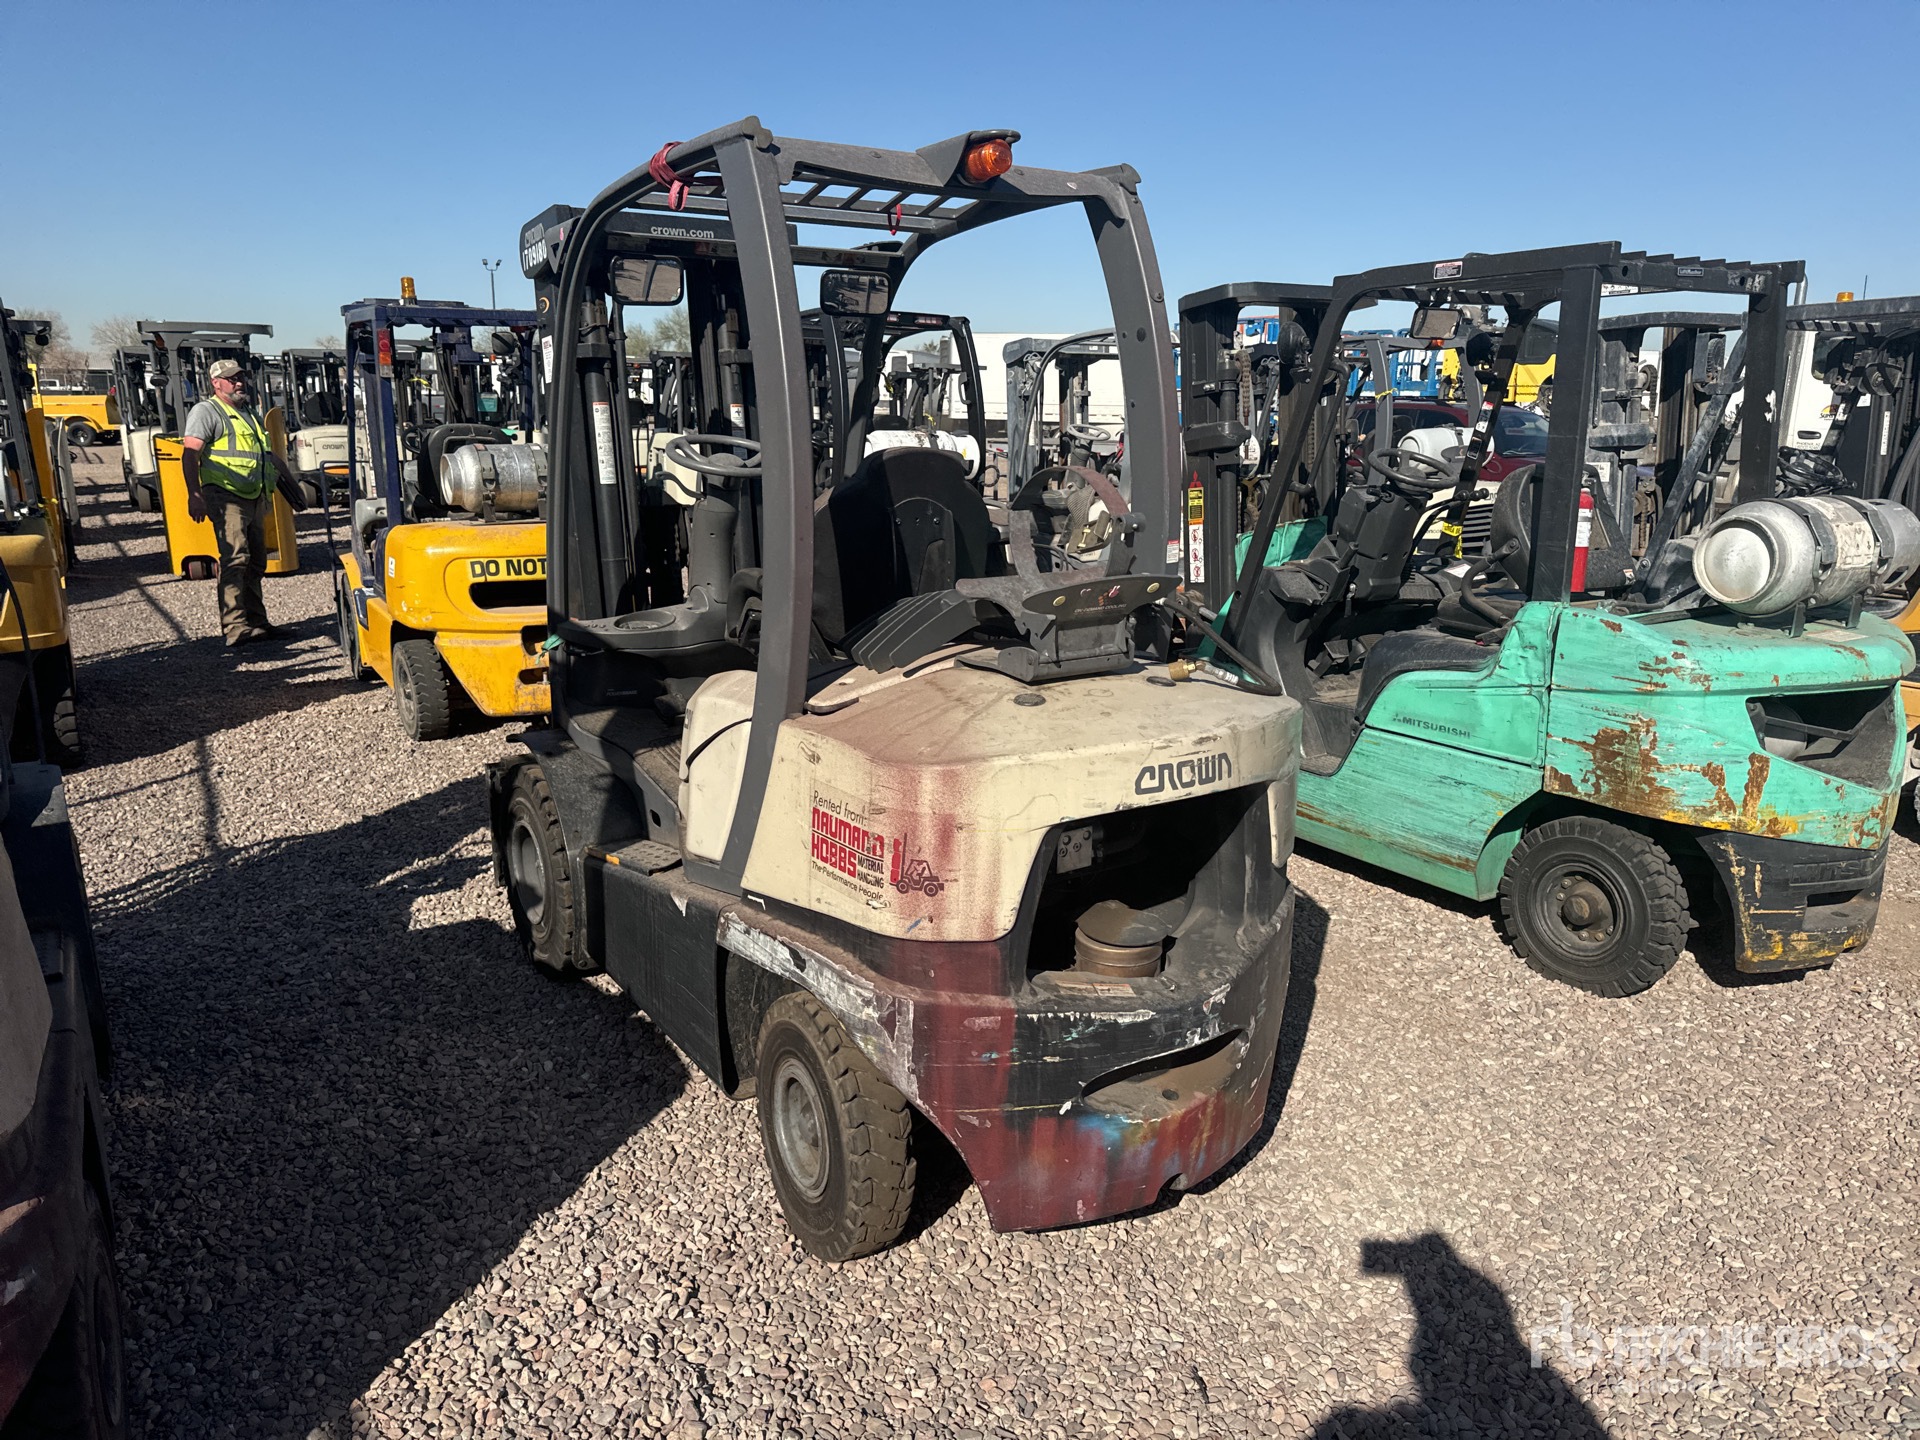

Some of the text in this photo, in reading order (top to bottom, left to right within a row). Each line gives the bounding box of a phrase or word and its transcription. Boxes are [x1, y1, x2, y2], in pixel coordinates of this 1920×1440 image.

[650, 226, 715, 239] crown.com
[470, 558, 547, 579] DO NOT
[1402, 716, 1471, 739] MITSUBISHI
[1134, 752, 1232, 796] CROWN
[813, 789, 842, 815] Rented
[811, 831, 857, 879] HOBBS
[822, 866, 858, 892] Performance
